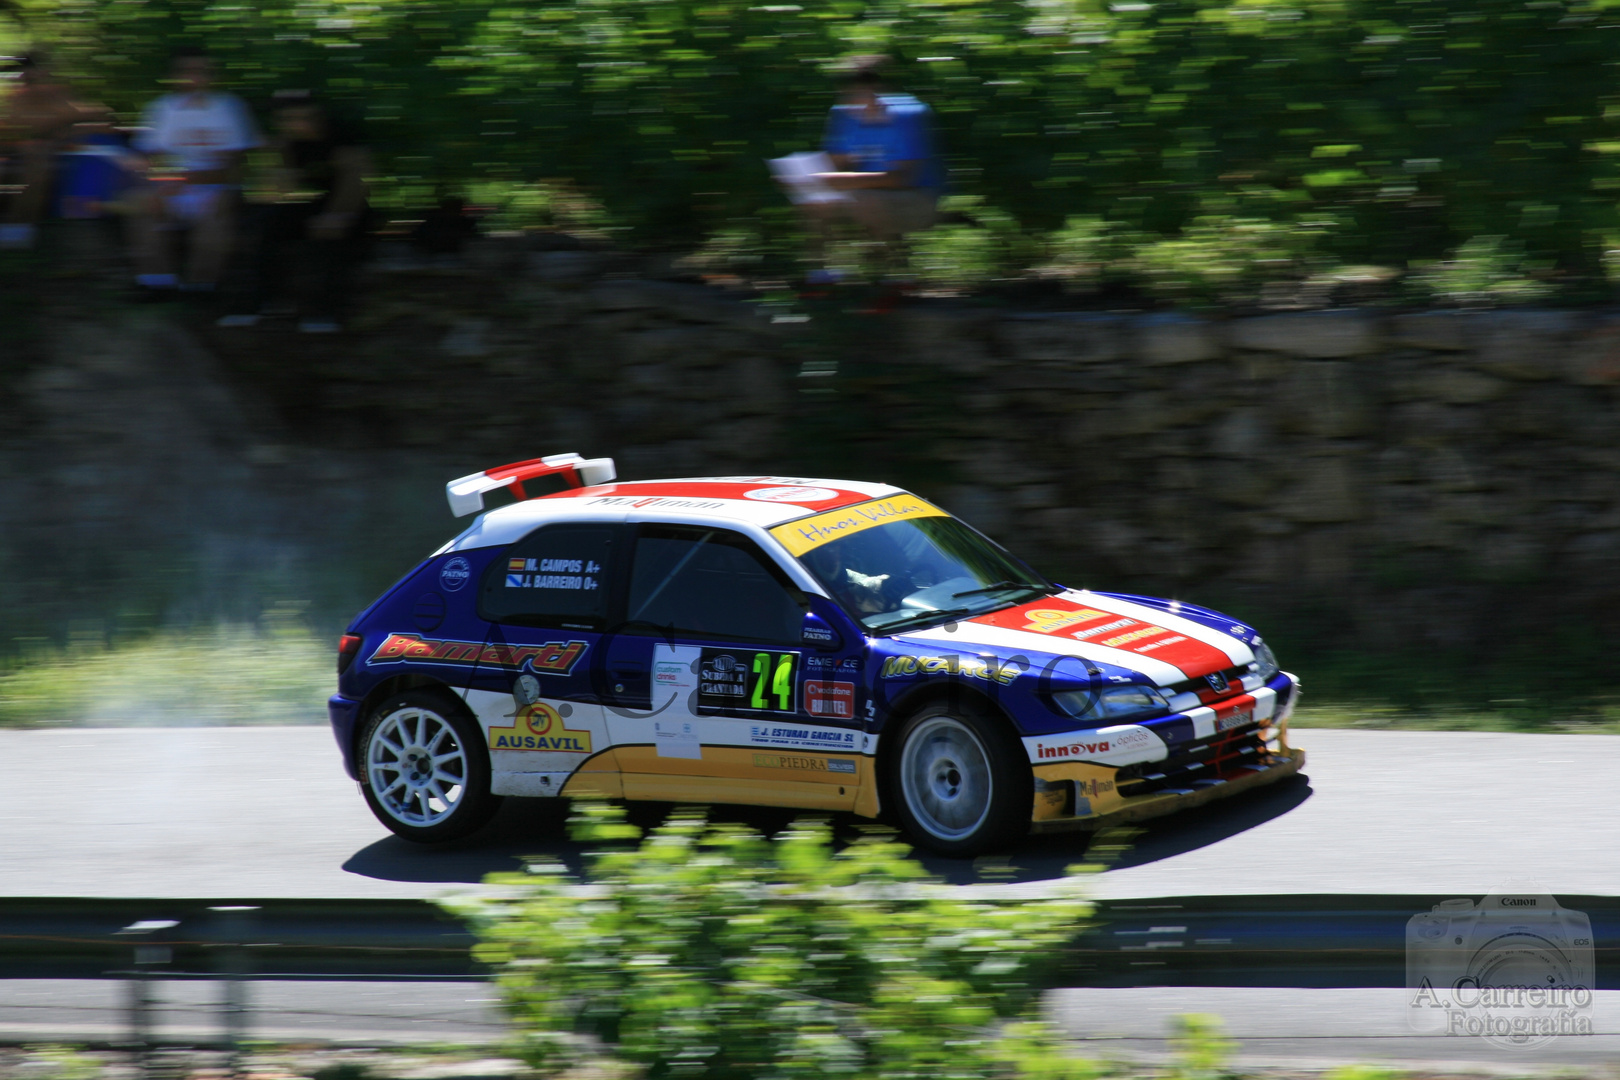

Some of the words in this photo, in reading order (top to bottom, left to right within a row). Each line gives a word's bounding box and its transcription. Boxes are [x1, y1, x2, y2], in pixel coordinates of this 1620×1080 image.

[525, 558, 538, 571] M.
[540, 559, 583, 573] CAMPOS
[585, 560, 602, 573] A+
[522, 575, 532, 588] J.
[533, 575, 583, 589] BARREIRO
[368, 633, 588, 675] Bamarti
[807, 656, 833, 666] EME
[656, 673, 676, 681] drinks
[750, 652, 794, 711] 24
[817, 686, 852, 696] vodafone
[761, 727, 769, 736] J.
[810, 731, 842, 741] GARCIA
[844, 733, 854, 742] SL
[495, 735, 585, 750] AUSAVIL
[1037, 741, 1110, 759] innova
